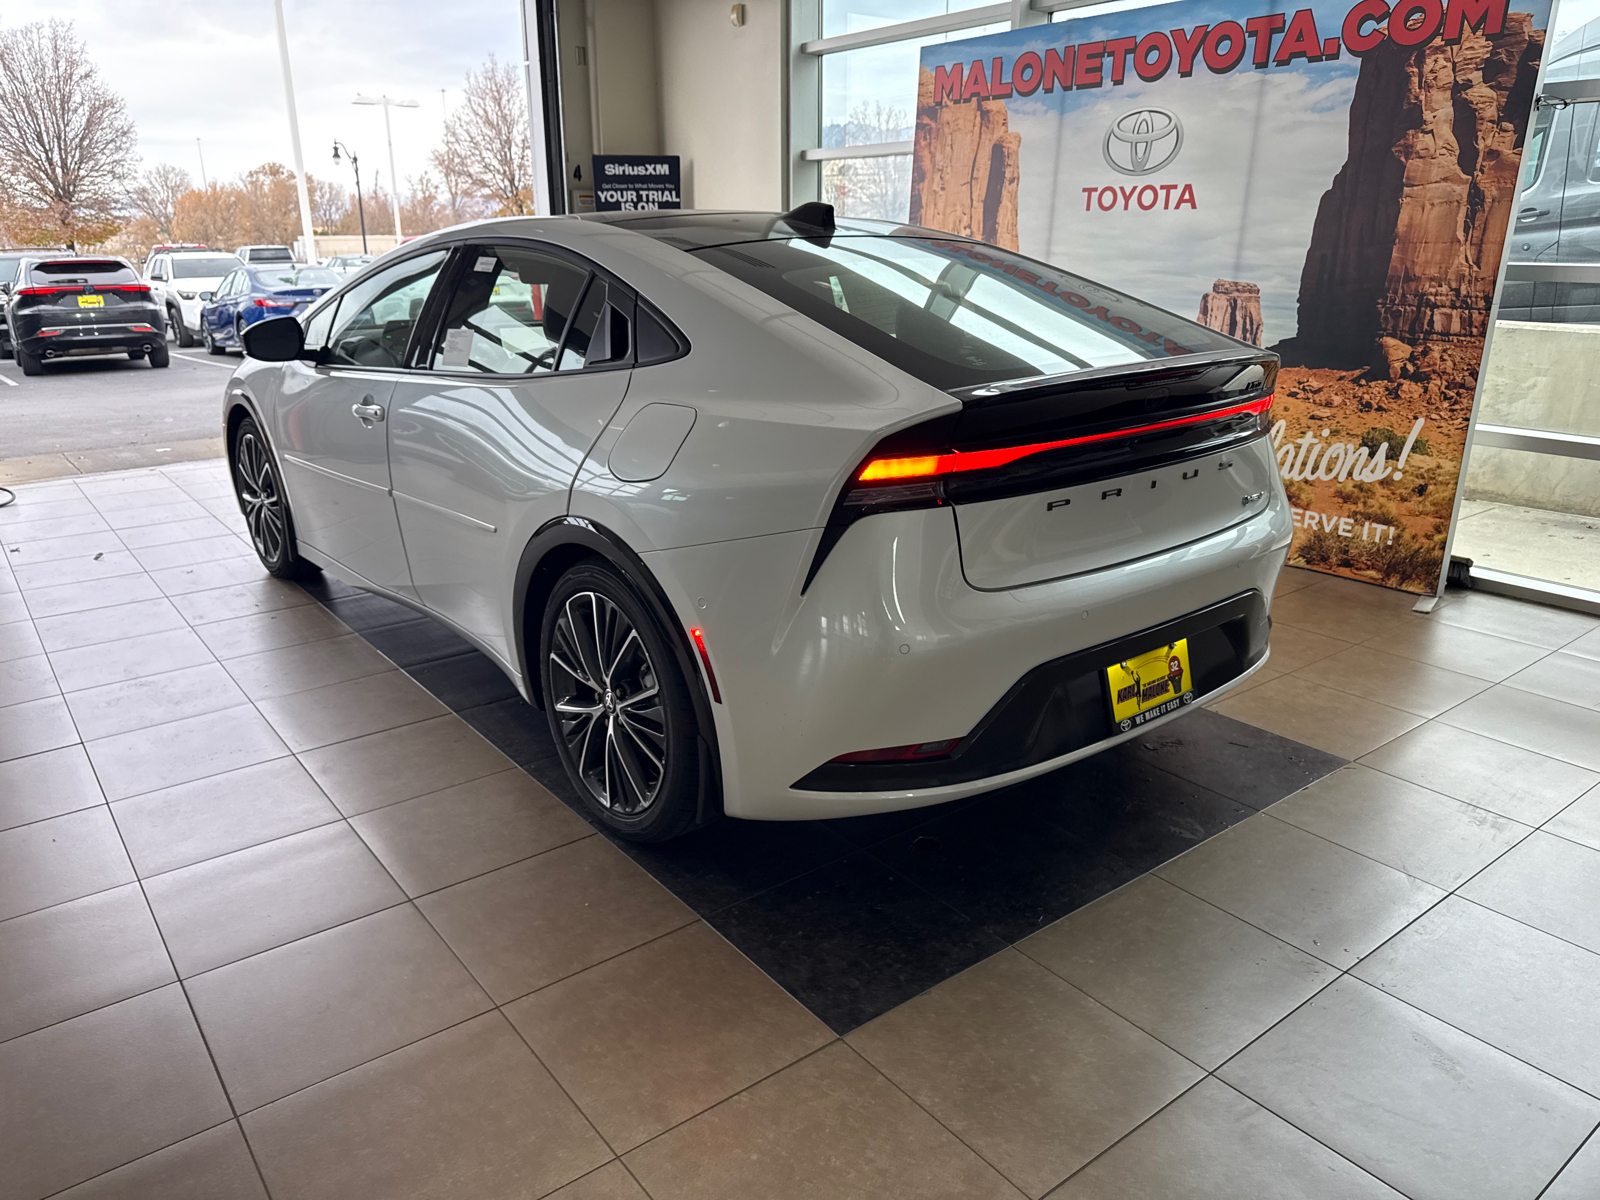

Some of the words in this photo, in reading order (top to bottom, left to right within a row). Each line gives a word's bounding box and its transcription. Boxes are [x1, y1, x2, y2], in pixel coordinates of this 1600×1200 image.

[933, 0, 1509, 106] MALONETOYOTA.COM
[573, 164, 582, 182] 4
[604, 163, 670, 176] SiriusXM
[597, 190, 637, 203] YOUR
[639, 190, 680, 203] TRIAL
[620, 202, 635, 212] IS
[637, 202, 659, 211] ON
[1082, 184, 1198, 212] TOYOTA
[1271, 418, 1425, 483] lations!
[1046, 459, 1234, 512] PRIUS
[1292, 508, 1355, 538] ERVE
[1362, 521, 1396, 546] IT!
[1170, 661, 1179, 672] 32
[1117, 685, 1138, 705] KARL
[1135, 715, 1144, 725] WE
[1145, 708, 1160, 721] MAKE
[1161, 704, 1167, 714] IT
[1167, 698, 1180, 711] EASY
